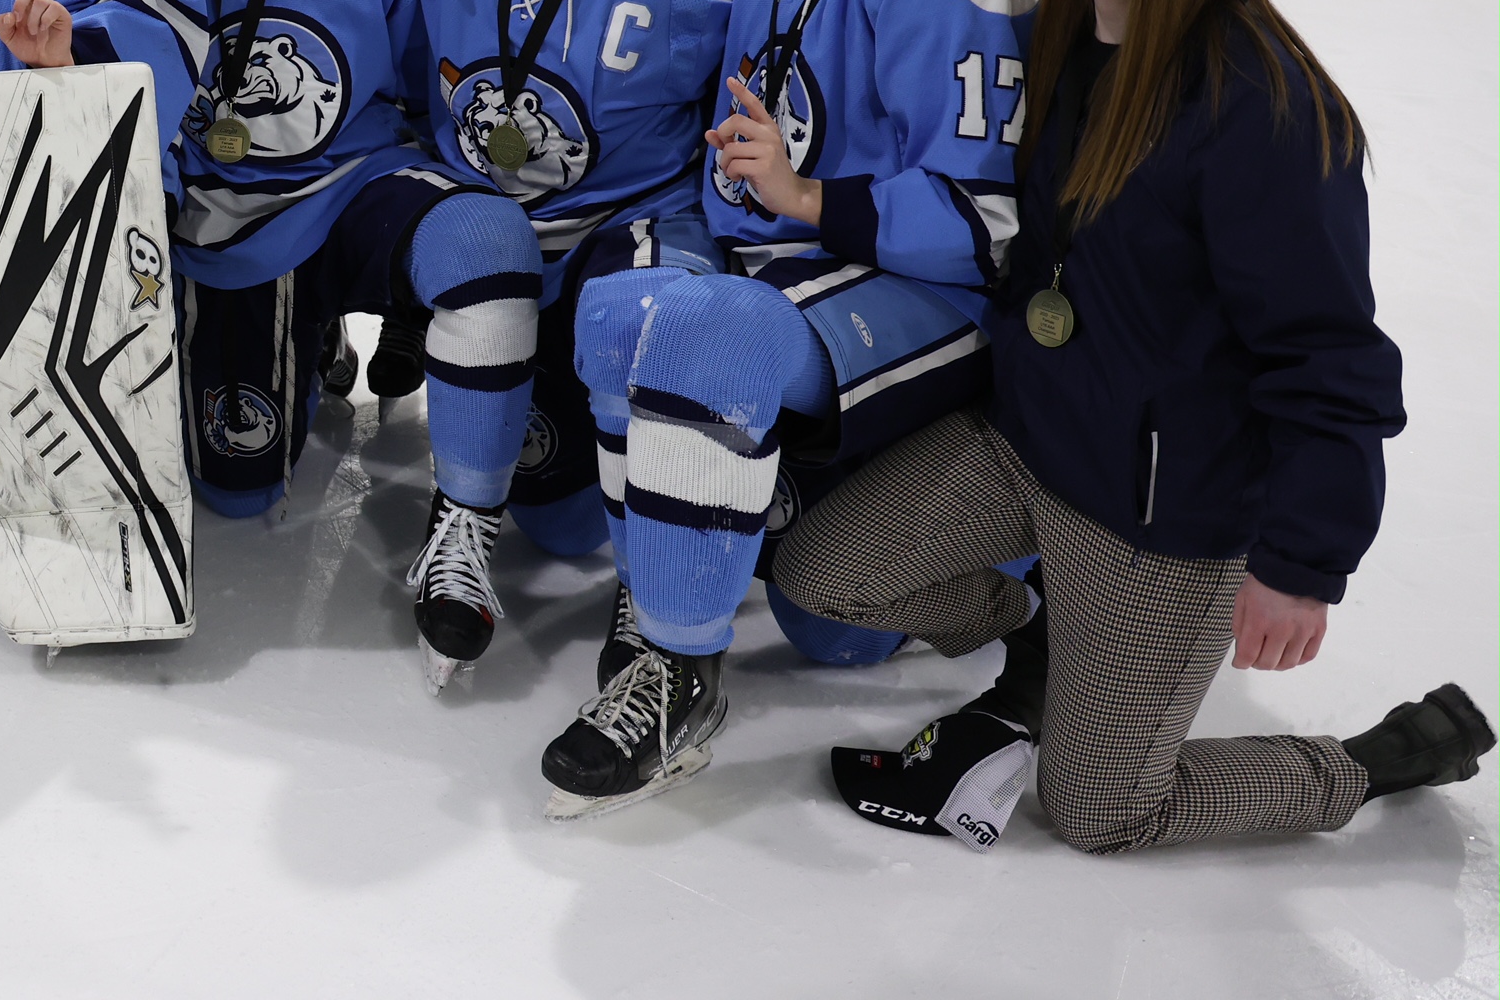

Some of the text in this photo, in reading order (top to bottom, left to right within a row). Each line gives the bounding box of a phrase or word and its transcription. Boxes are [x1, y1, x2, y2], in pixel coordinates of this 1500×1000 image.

[600, 1, 653, 72] C
[954, 50, 1026, 146] 17
[859, 799, 927, 826] CCM
